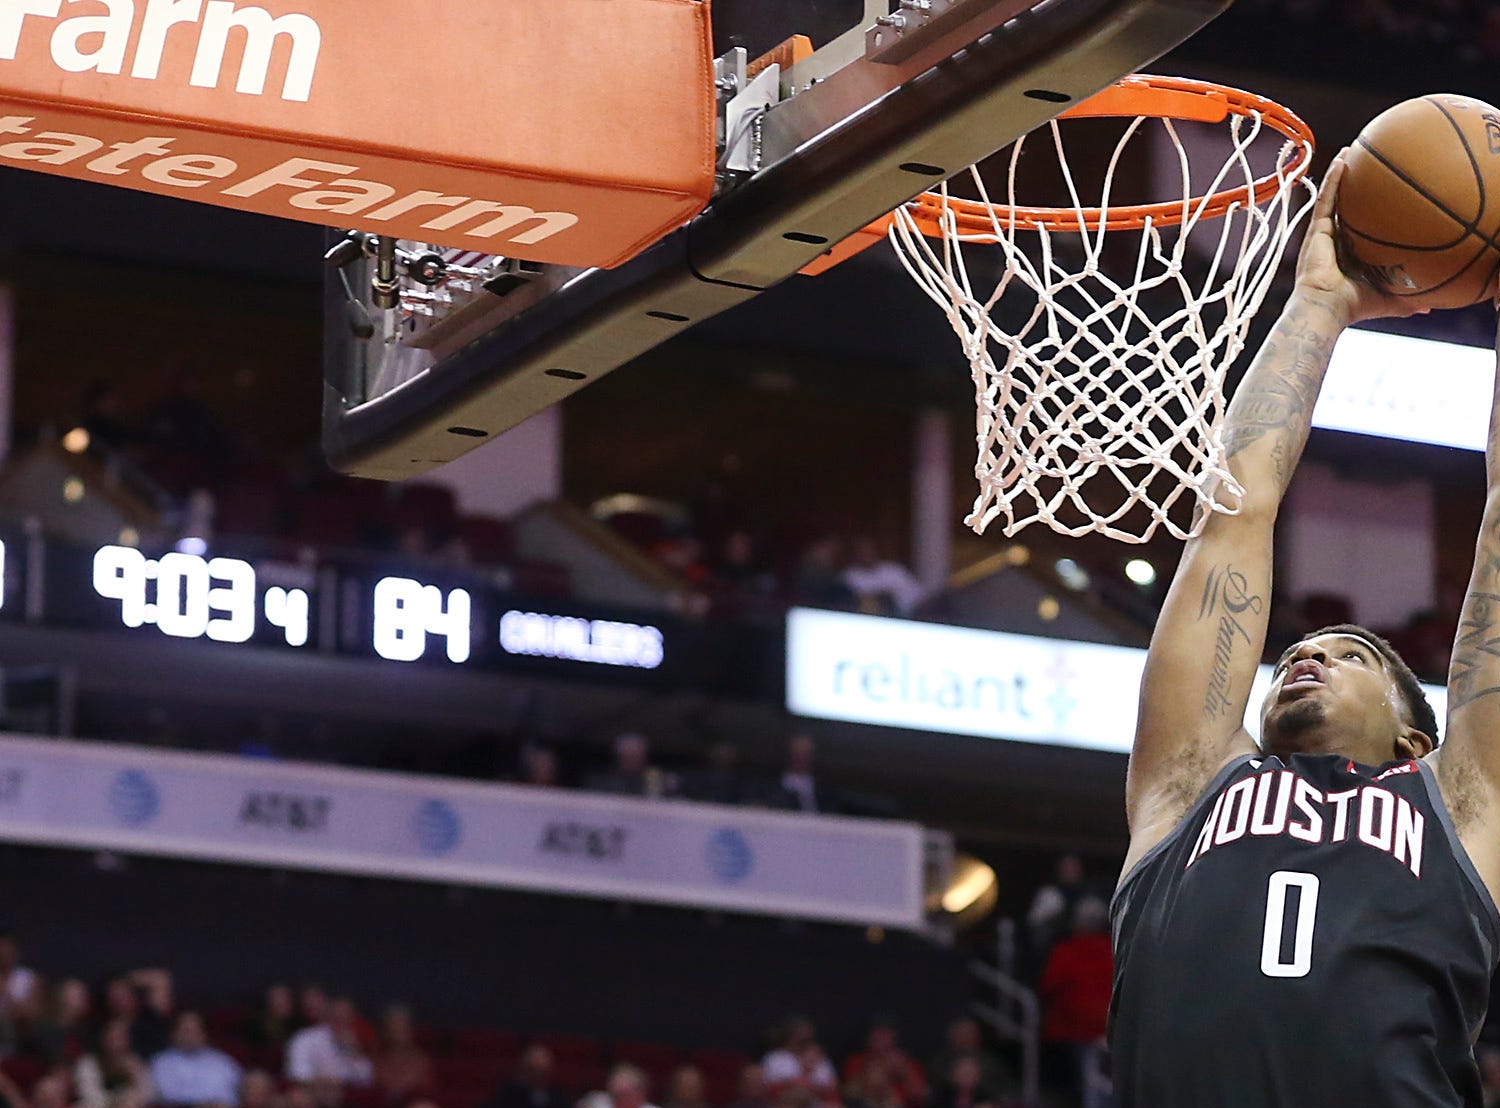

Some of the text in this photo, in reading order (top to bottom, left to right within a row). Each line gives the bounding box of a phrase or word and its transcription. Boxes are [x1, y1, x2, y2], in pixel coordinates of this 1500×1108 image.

[220, 157, 579, 245] Farm
[93, 545, 256, 643] 9:03
[373, 576, 471, 663] 84
[832, 651, 1034, 720] reliant
[236, 790, 332, 834] AT&T
[536, 820, 629, 861] AT&T
[1184, 769, 1425, 880] HOUSTON
[1260, 870, 1320, 978] 0
